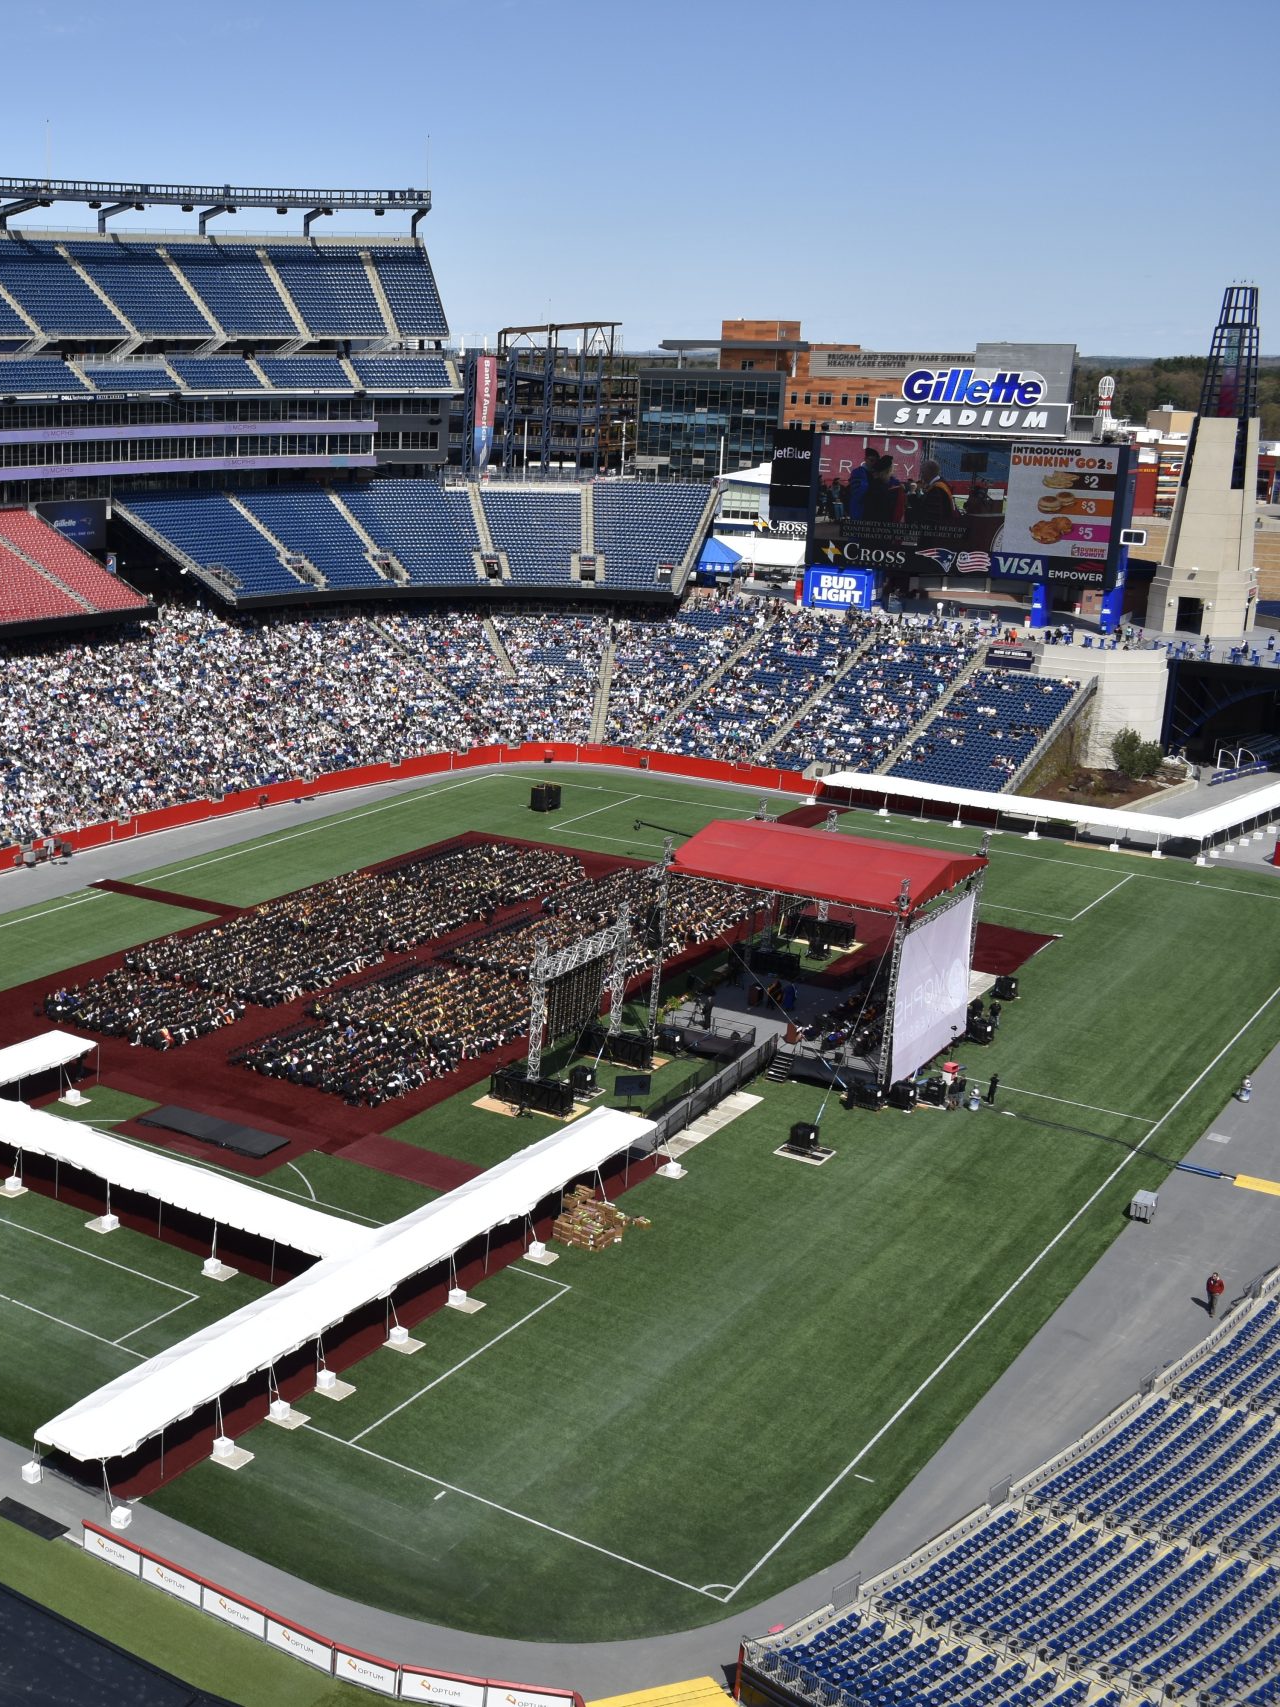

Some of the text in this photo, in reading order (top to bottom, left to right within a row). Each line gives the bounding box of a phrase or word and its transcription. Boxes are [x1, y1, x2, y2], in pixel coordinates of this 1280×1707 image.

[484, 387, 490, 397] of
[902, 367, 1045, 407] Gillette
[481, 398, 490, 441] America
[893, 407, 1048, 429] STADIUM
[773, 447, 811, 460] jetBlue
[1013, 446, 1081, 456] INTRODUCING
[1012, 455, 1074, 468] DUNKIN'
[1084, 475, 1099, 488] $2
[1081, 500, 1096, 513] $3
[1078, 527, 1093, 539] $5
[994, 556, 1043, 576] VISA
[820, 575, 857, 590] BUD
[1048, 569, 1103, 582] EMPOWER
[813, 587, 863, 604] LIGHT
[104, 1546, 126, 1560] OPTUM
[163, 1576, 185, 1590] OPTUM
[227, 1607, 250, 1621] OPTUM
[290, 1639, 314, 1654] OPTUM
[357, 1667, 384, 1681] OPTUM
[431, 1687, 461, 1697] OPTUM
